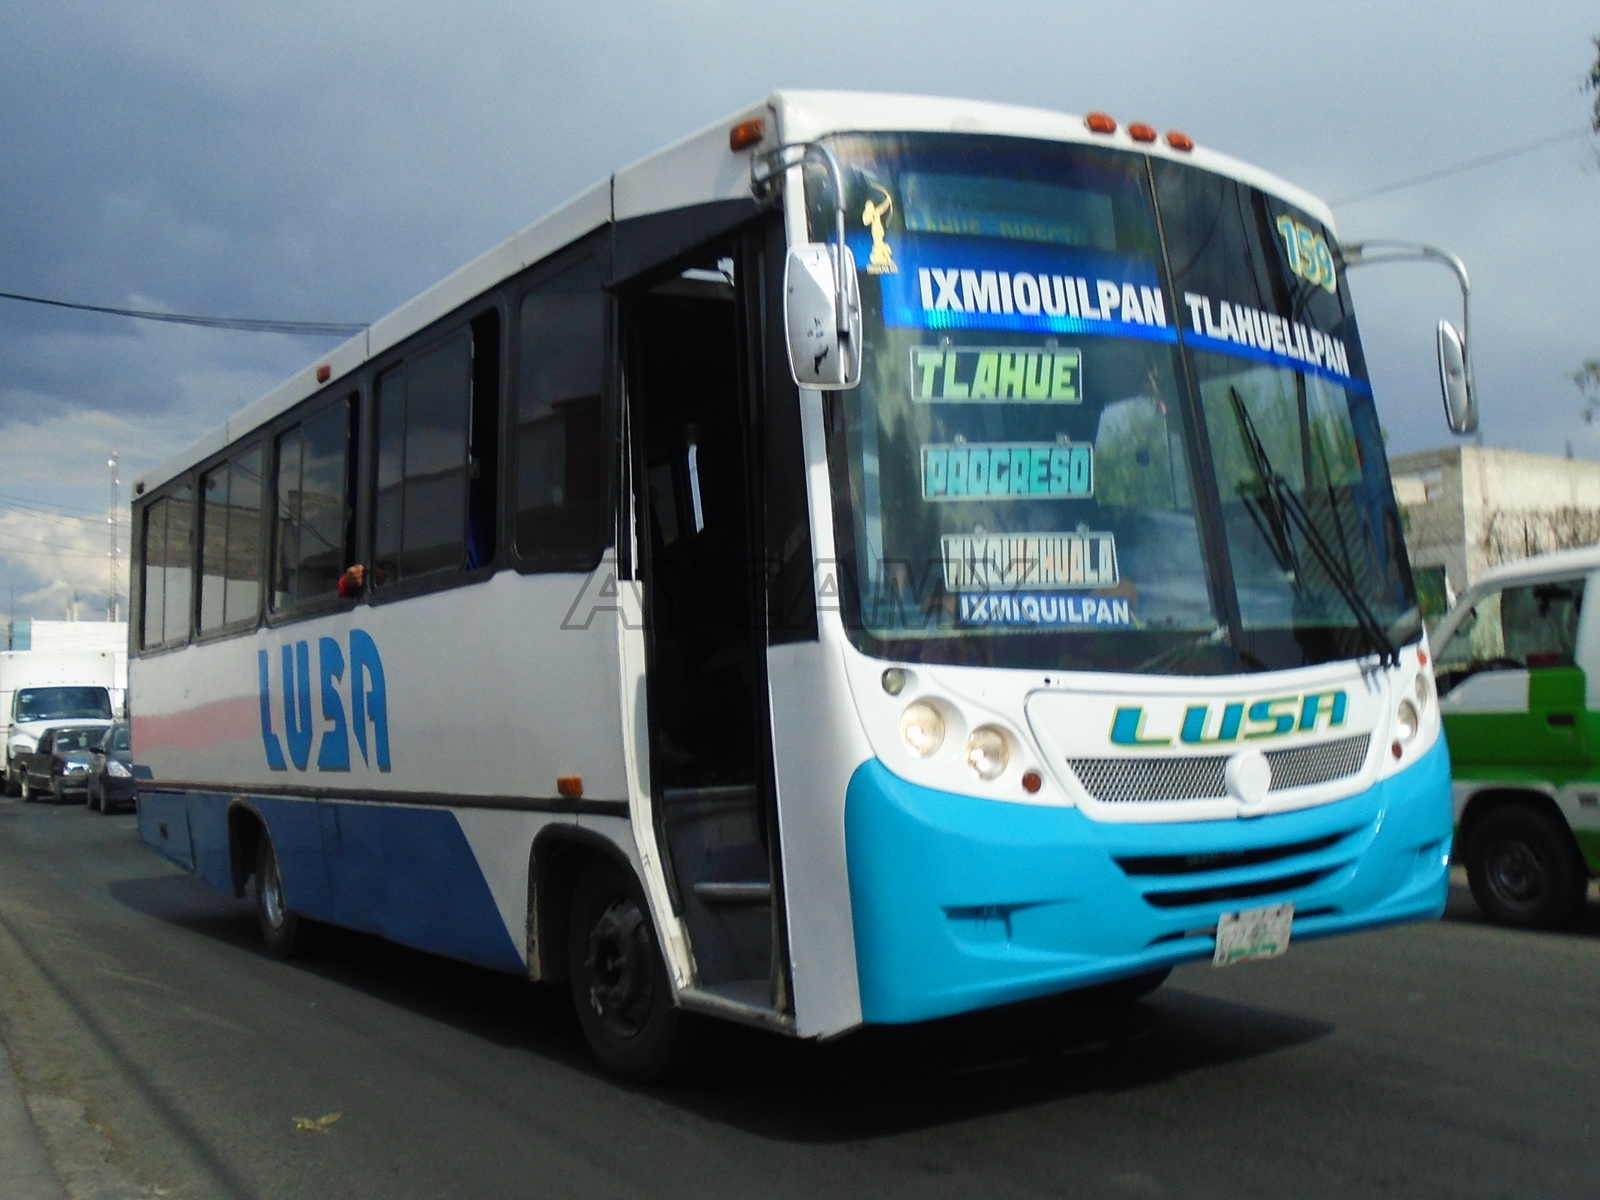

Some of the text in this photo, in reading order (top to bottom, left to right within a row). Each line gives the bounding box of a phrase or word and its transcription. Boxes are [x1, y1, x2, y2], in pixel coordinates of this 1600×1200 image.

[1277, 215, 1336, 294] 159
[918, 267, 1166, 328] IXMIQUILPAN
[1184, 291, 1350, 378] TLAHUELILPAN
[917, 351, 1078, 399] TLAHUE
[961, 594, 1130, 625] IXMIQUILPAN
[258, 629, 391, 772] LUSA
[1109, 690, 1349, 748] LUSA
